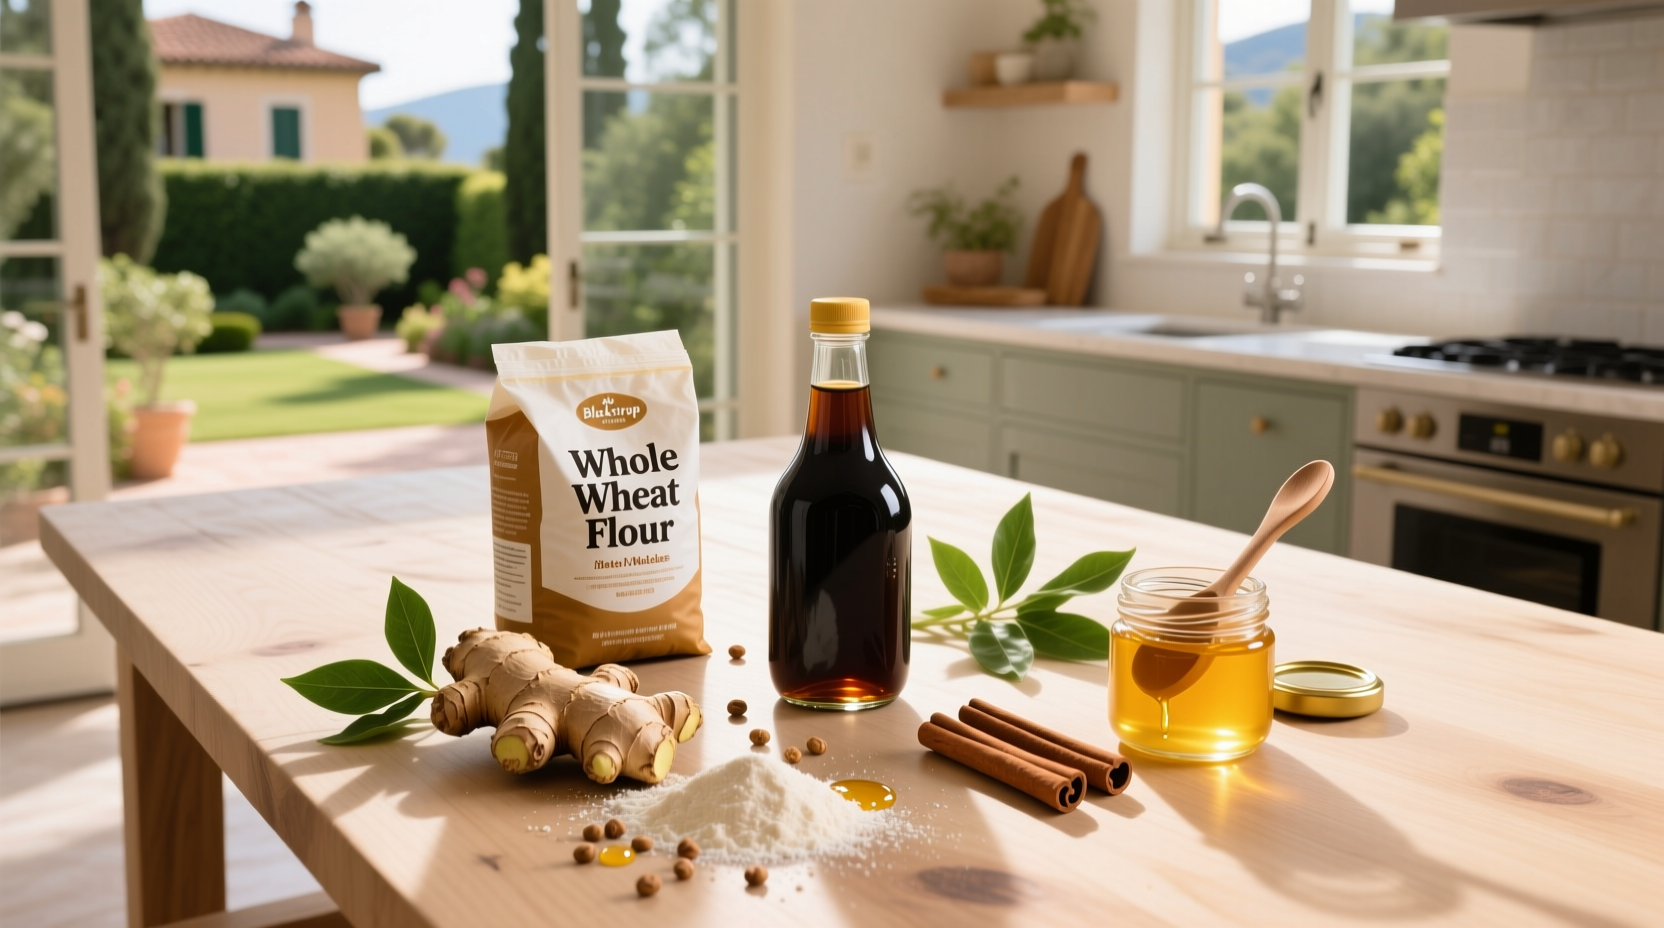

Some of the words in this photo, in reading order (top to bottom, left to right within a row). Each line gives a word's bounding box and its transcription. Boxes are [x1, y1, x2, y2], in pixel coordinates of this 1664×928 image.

[568, 442, 679, 478] Whole
[571, 478, 680, 514] Wheat
[585, 516, 674, 549] Flour
